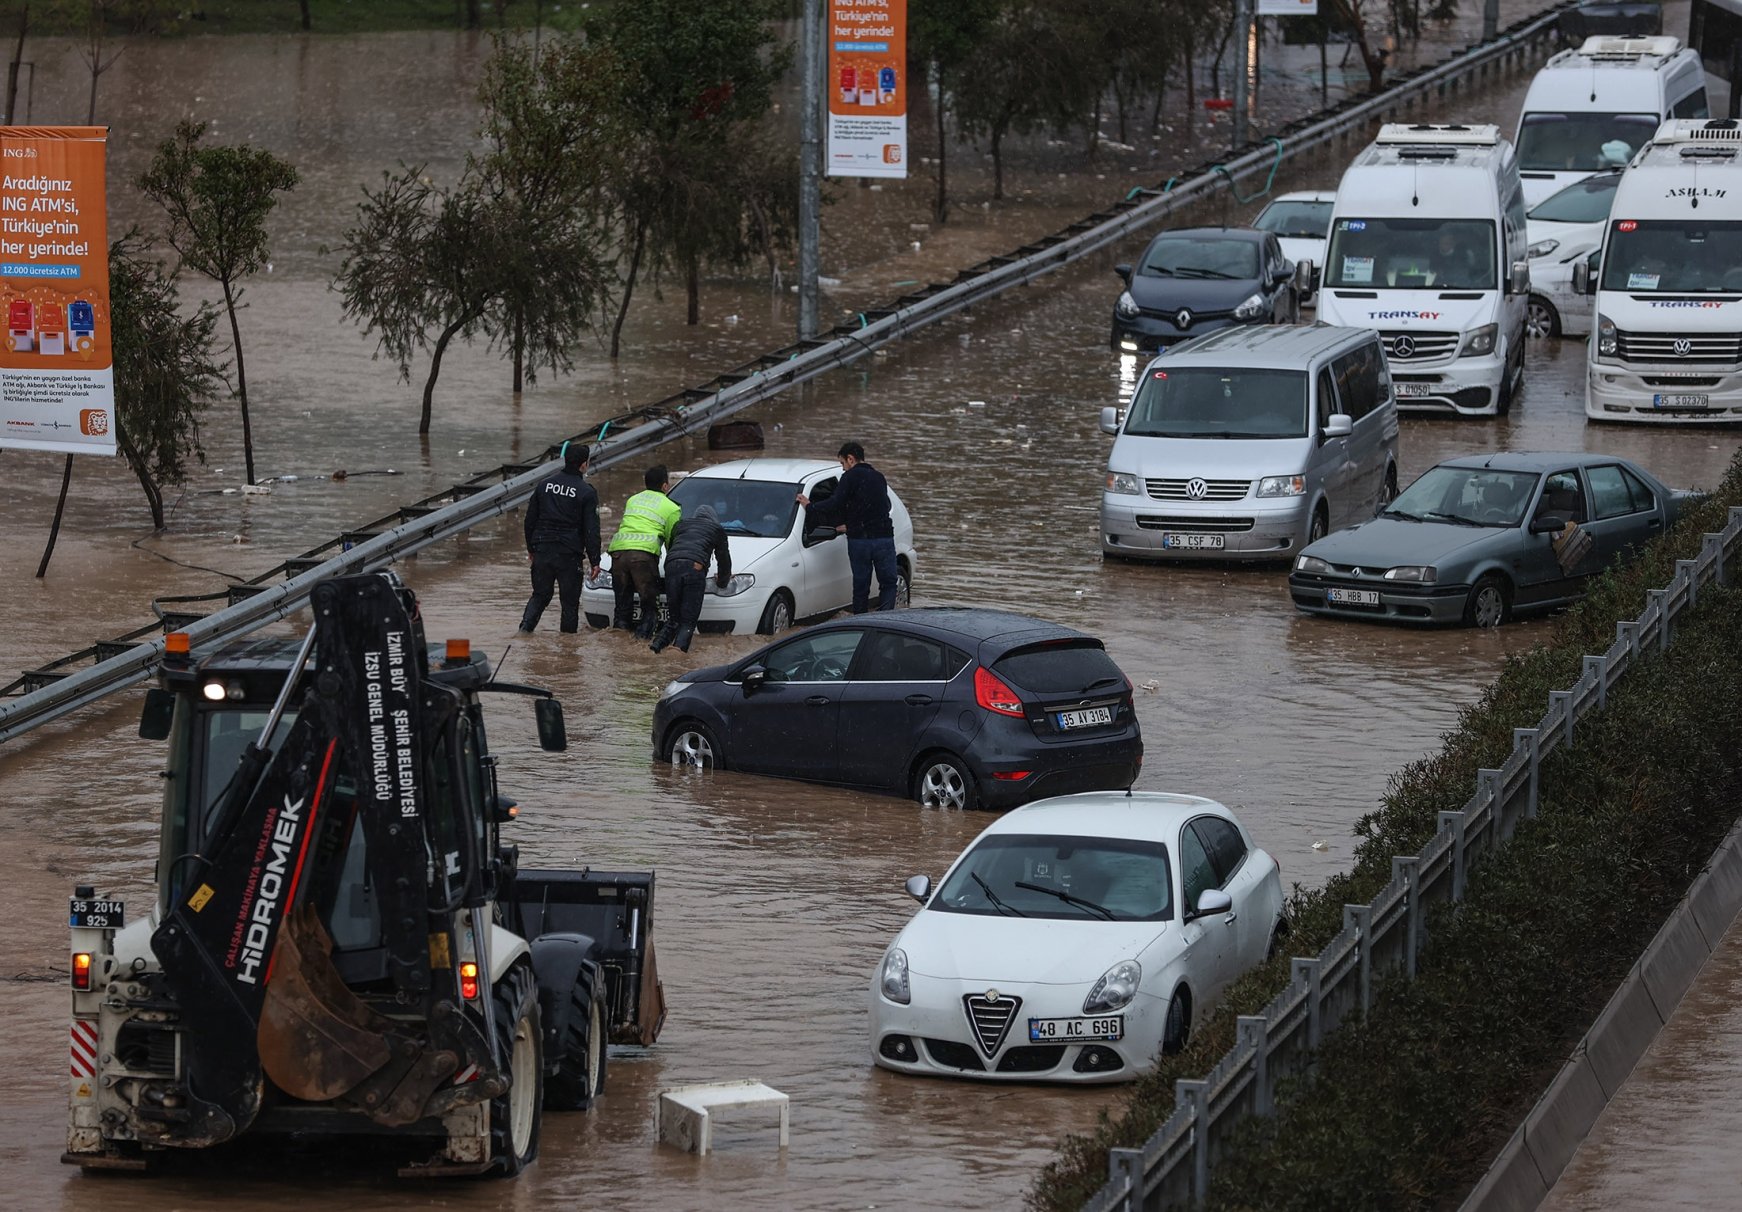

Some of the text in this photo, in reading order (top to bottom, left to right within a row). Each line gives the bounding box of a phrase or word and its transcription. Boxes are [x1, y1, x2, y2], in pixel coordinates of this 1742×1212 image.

[835, 25, 894, 39] her yerinde!
[3, 149, 23, 158] ING
[2, 175, 72, 195] Aradığınız
[2, 197, 79, 215] ING ATM'si,
[1, 218, 79, 238] Türkiye'nin
[1, 238, 89, 259] her yerinde!
[3, 266, 78, 275] 12.000 ücretsiz ATM
[1650, 301, 1723, 309] TRANSAY
[1368, 311, 1440, 320] TRANSAY
[1170, 535, 1222, 547] 35 CSF 78
[1333, 590, 1342, 600] 35
[1368, 592, 1378, 603] 17
[386, 631, 406, 666] İZMİR
[365, 652, 393, 800] İZSU GENEL MÜDÜRLÜĞÜ
[1062, 713, 1075, 726] 35
[390, 709, 413, 746] ŞEHİR
[397, 748, 419, 818] BELEDİYESİ
[224, 922, 245, 968] ÇALIŞAN
[254, 807, 278, 863] YAKLAŞMA
[73, 902, 121, 914] 35 2014
[86, 915, 108, 926] 925
[1039, 1022, 1056, 1036] 48
[1066, 1020, 1083, 1036] AC
[1093, 1019, 1118, 1034] 696
